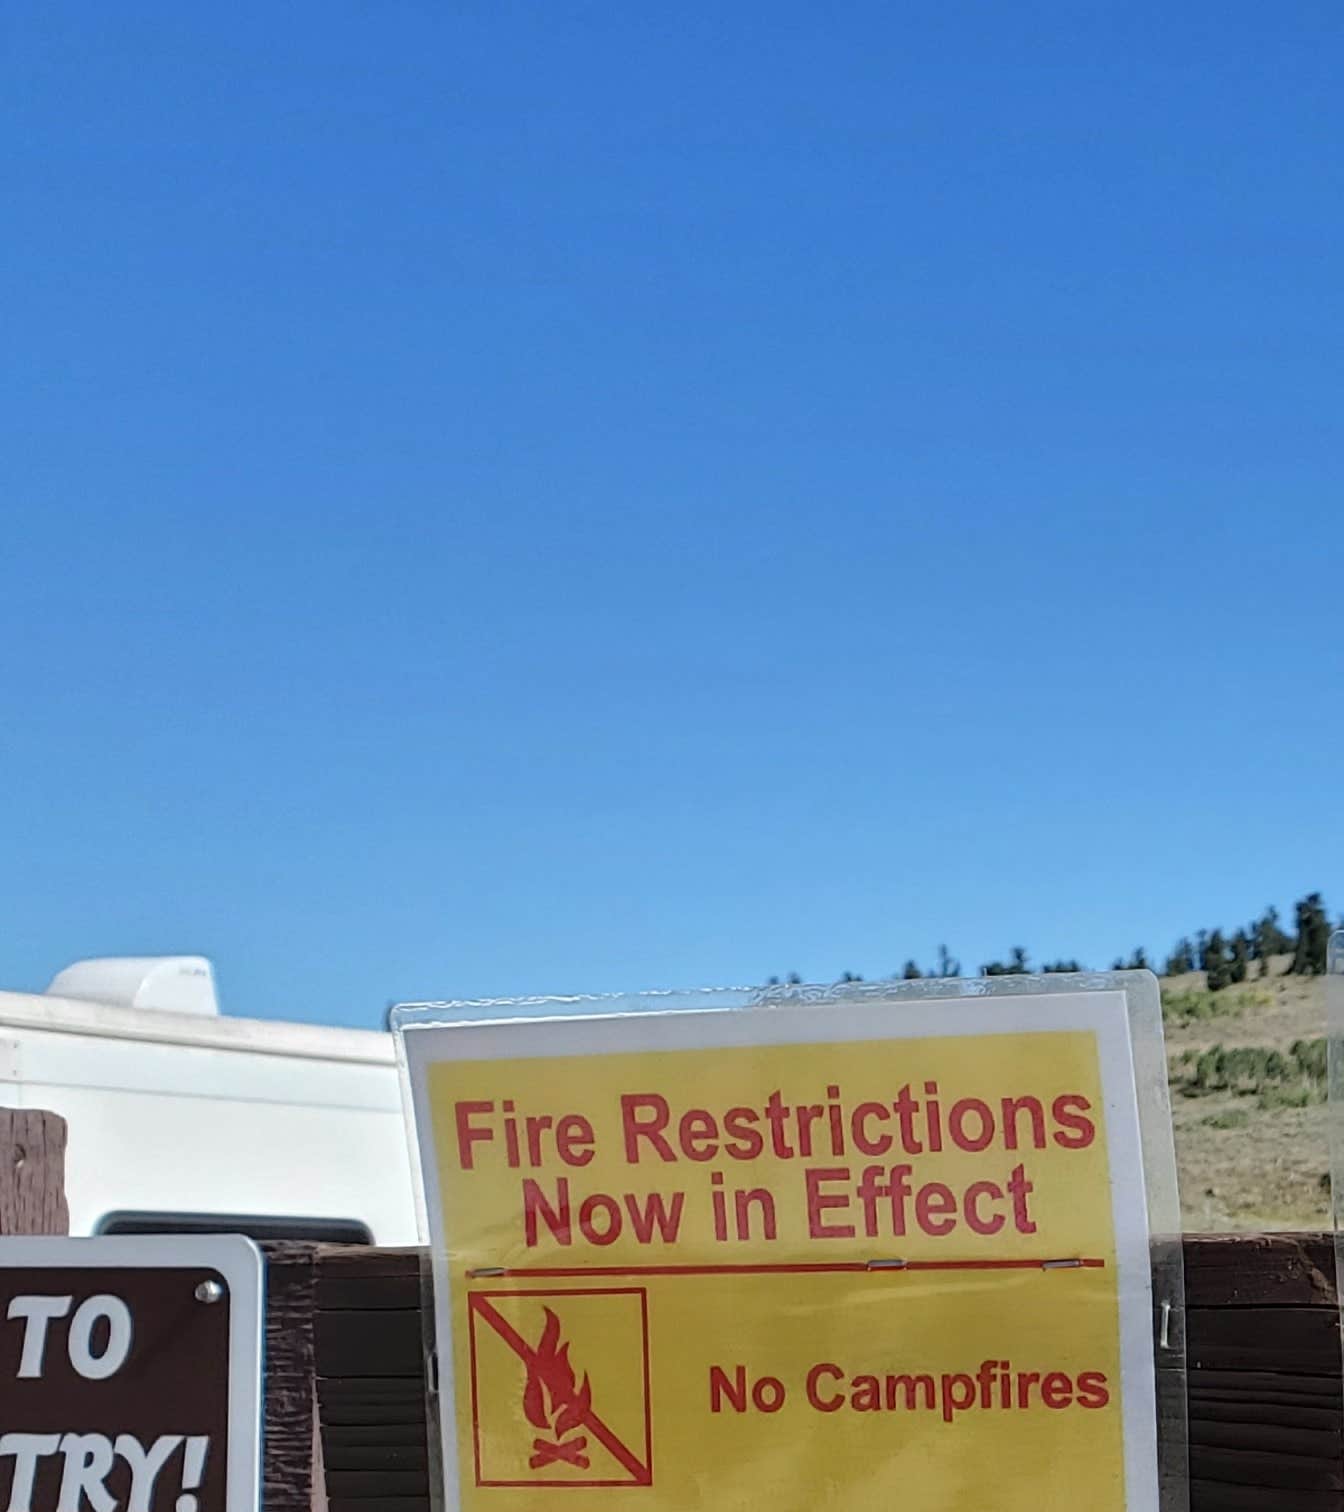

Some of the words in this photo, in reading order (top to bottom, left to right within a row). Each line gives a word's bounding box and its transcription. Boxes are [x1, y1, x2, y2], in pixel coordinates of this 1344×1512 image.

[456, 1099, 595, 1169] Fire
[621, 1083, 1095, 1165] Restrictions
[522, 1178, 684, 1247] Now
[713, 1172, 776, 1240] in
[806, 1165, 1037, 1239] Effect
[7, 1294, 132, 1380] TO
[709, 1367, 786, 1414] No
[806, 1364, 1110, 1422] Campfires
